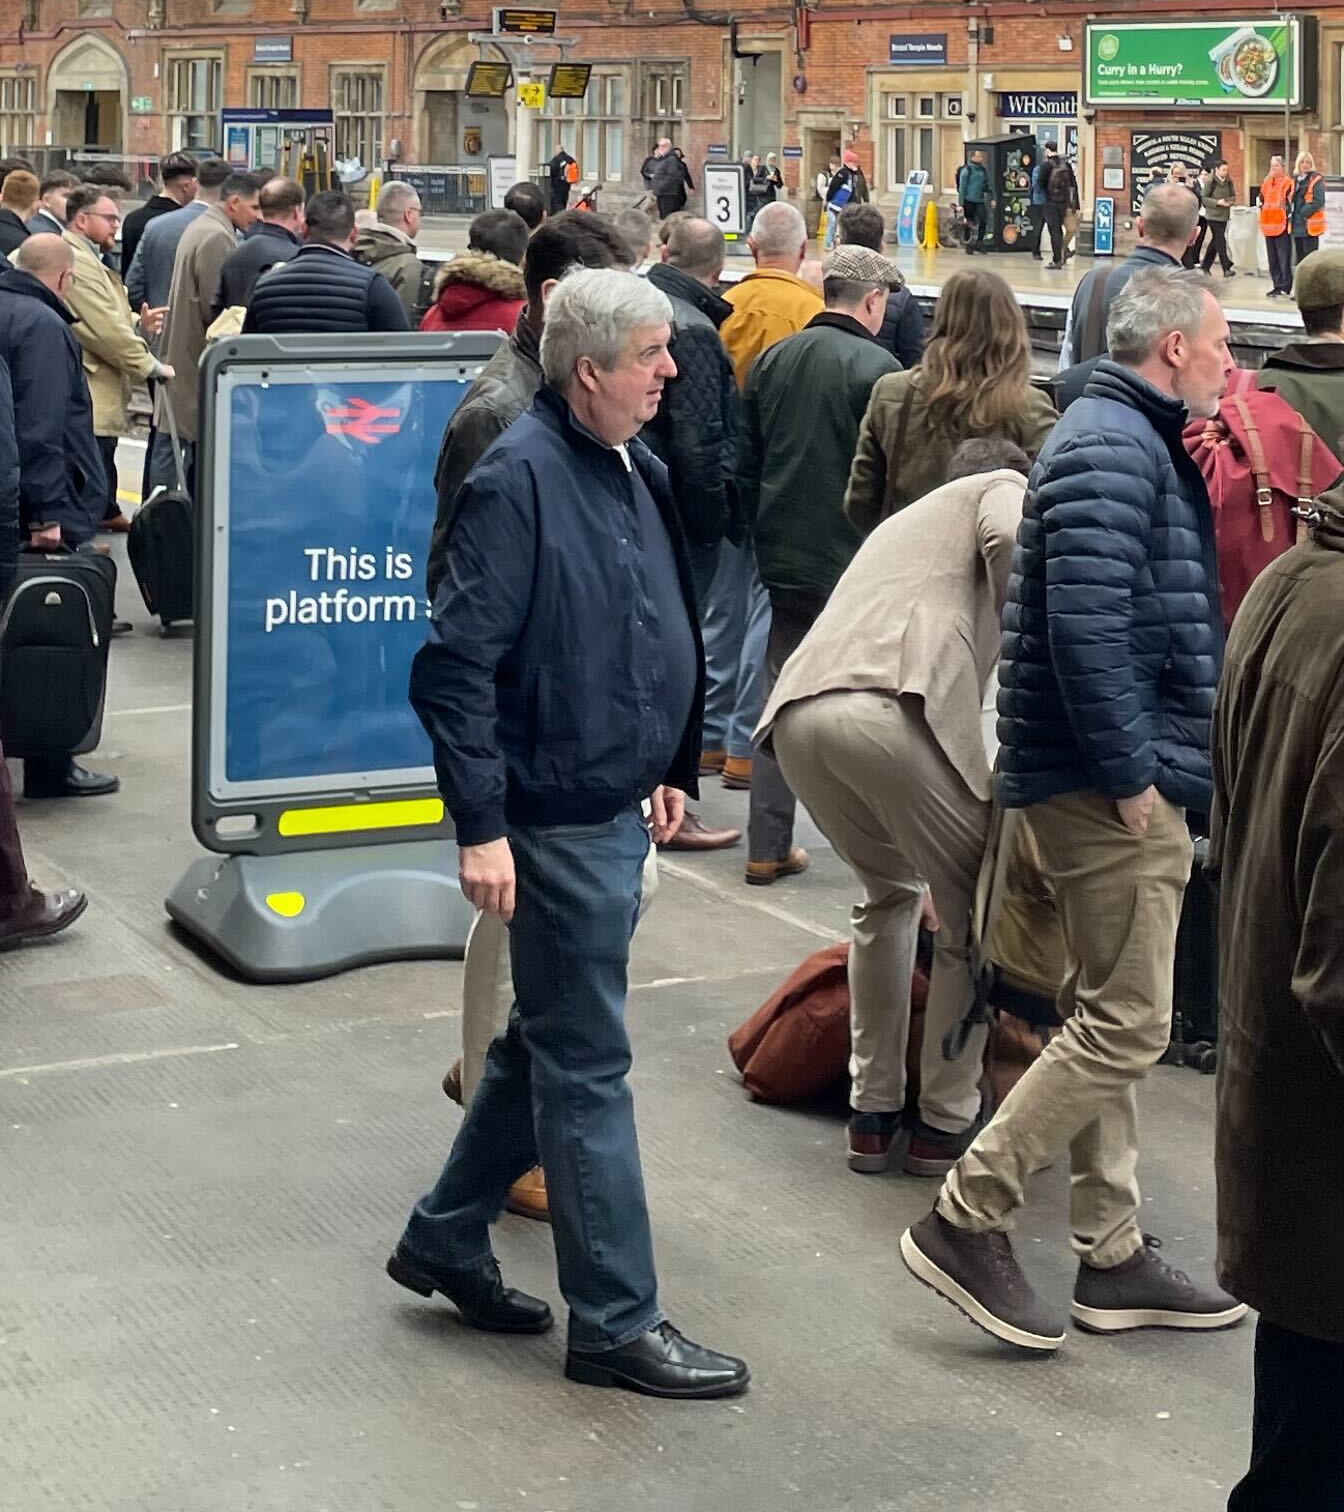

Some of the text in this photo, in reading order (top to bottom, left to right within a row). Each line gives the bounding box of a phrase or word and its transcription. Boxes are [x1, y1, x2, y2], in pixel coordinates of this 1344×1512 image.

[1097, 63, 1183, 77] Curry in a Hurry?
[717, 196, 730, 222] 3
[304, 546, 413, 580] This is
[265, 588, 416, 632] platform
